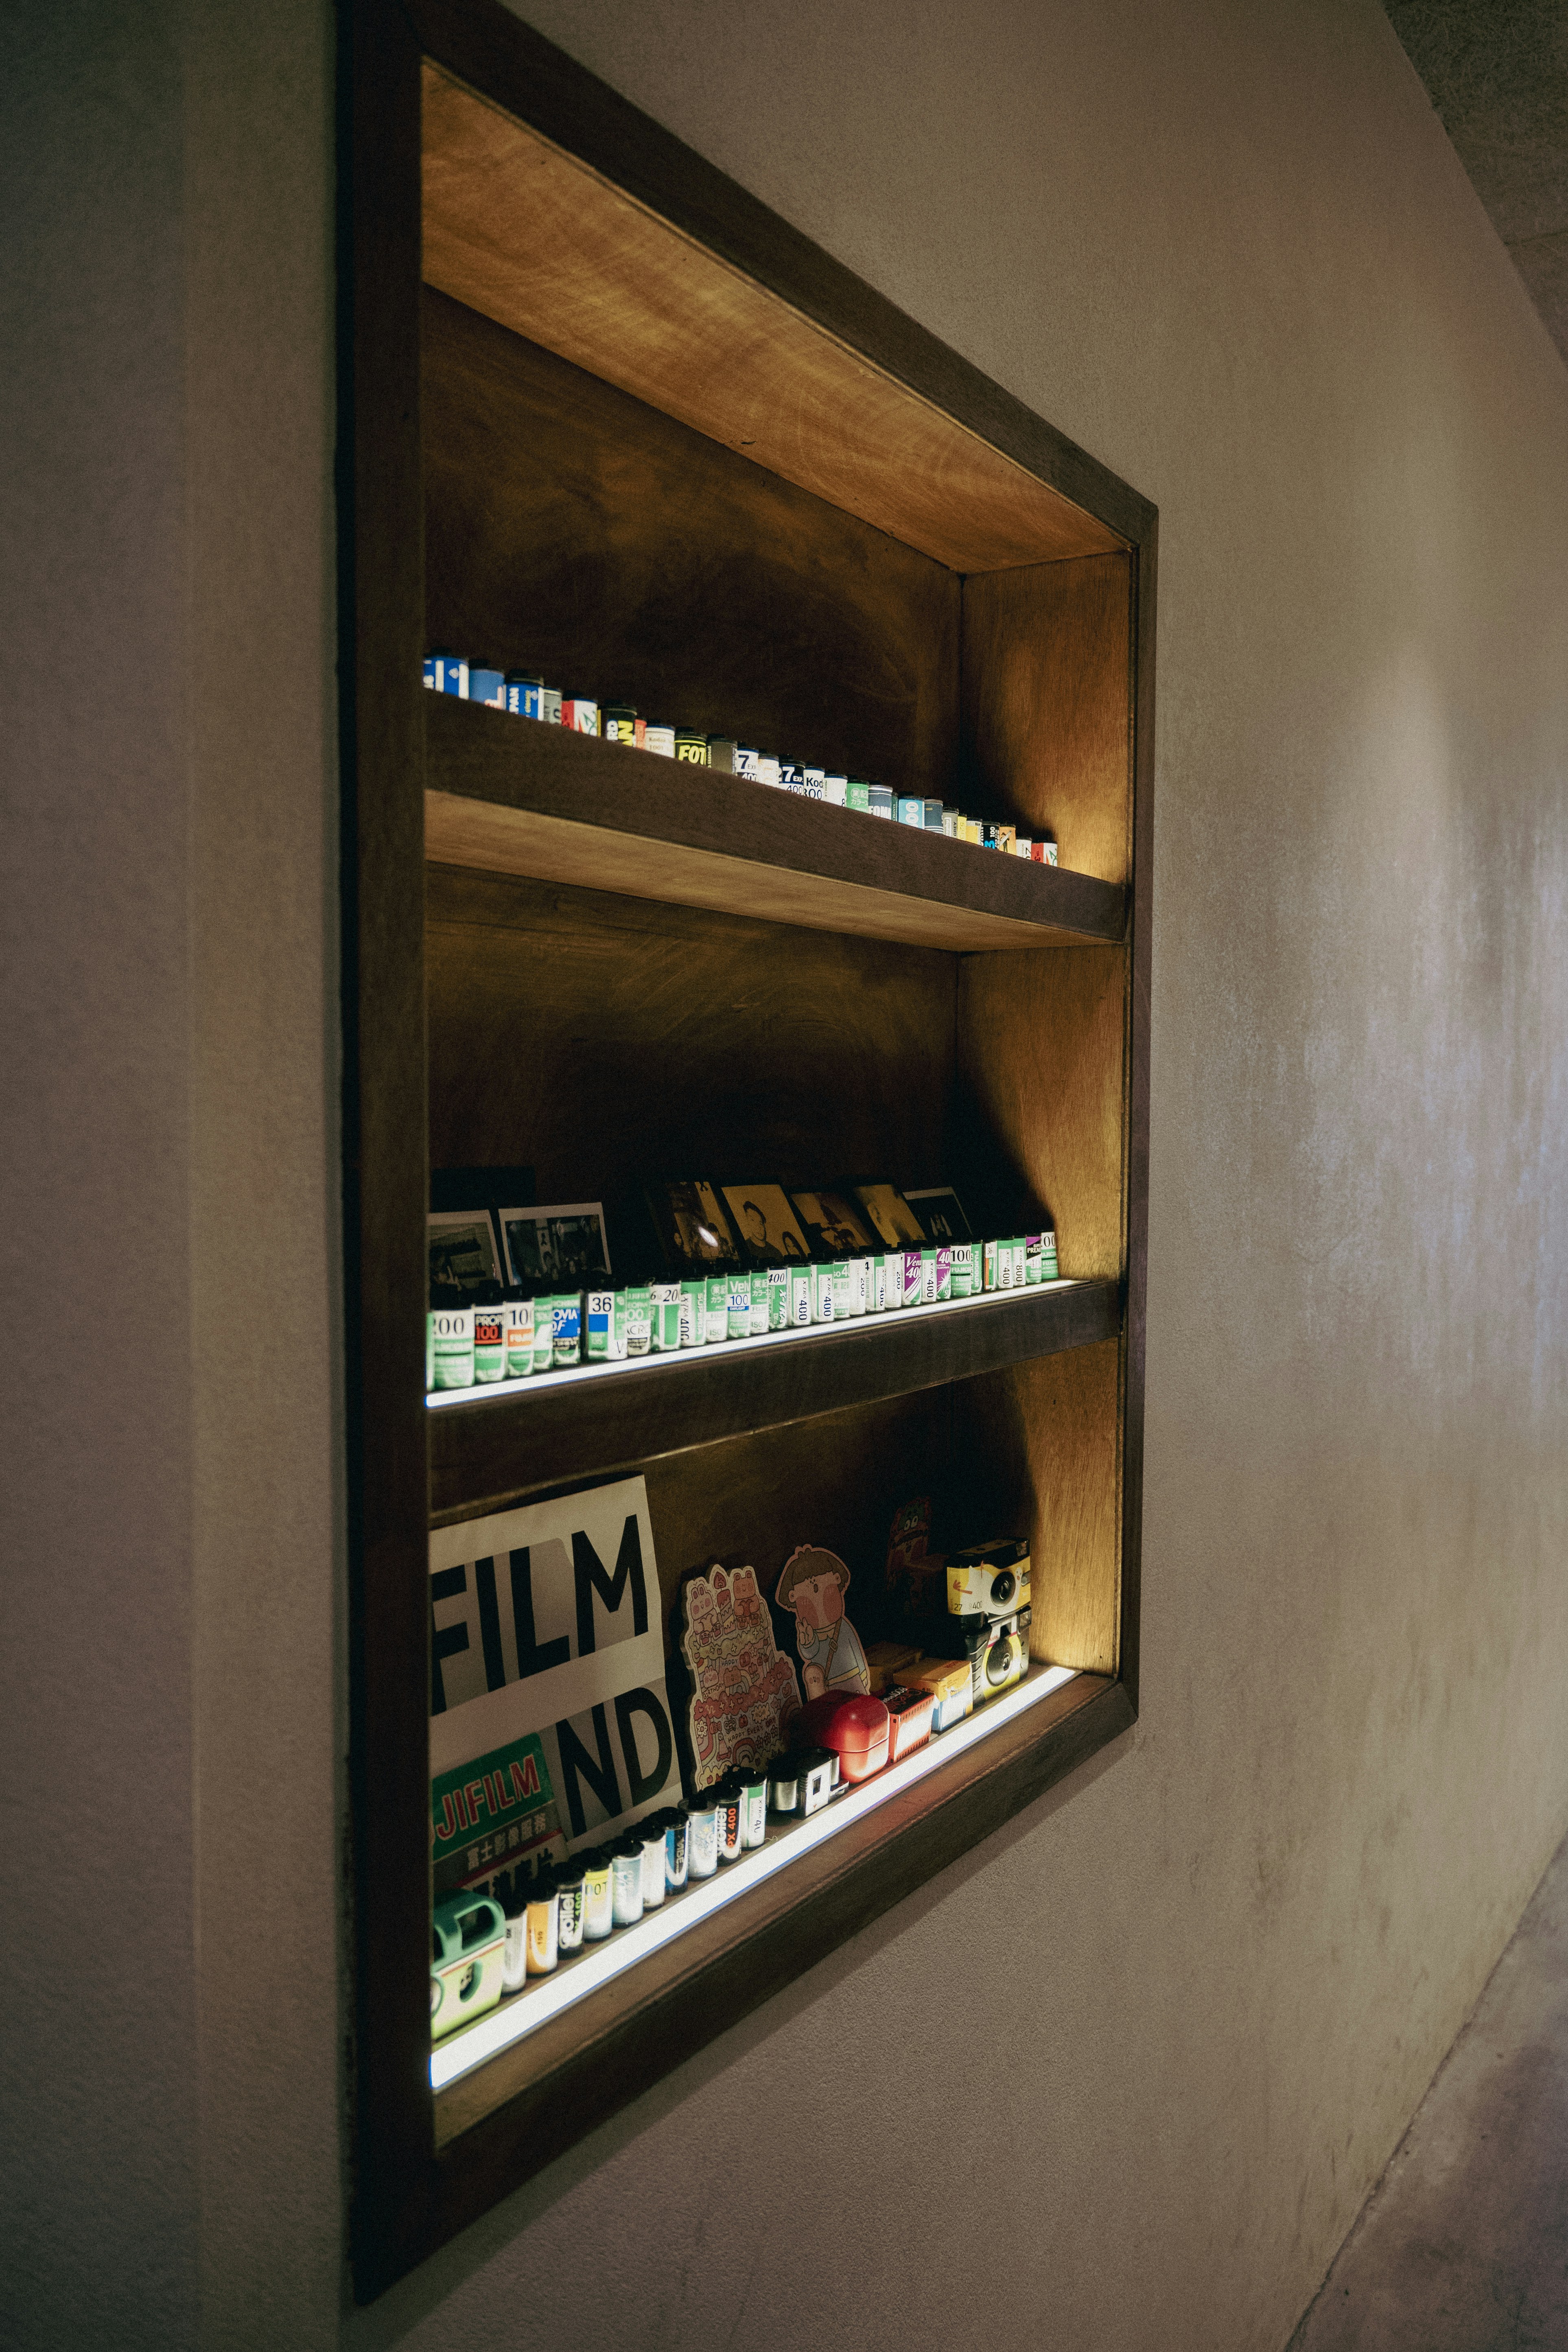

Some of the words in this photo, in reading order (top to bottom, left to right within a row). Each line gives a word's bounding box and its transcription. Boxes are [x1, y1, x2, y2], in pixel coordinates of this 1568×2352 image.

[738, 754, 749, 769] 7
[951, 1249, 971, 1262] 100
[768, 1273, 785, 1283] 400
[592, 1297, 612, 1312] 36
[730, 1294, 748, 1306] 100
[823, 1296, 831, 1317] 400
[798, 1300, 807, 1321] 400
[475, 1326, 499, 1340] 100
[954, 1603, 962, 1611] 27
[972, 1600, 982, 1610] 400
[430, 1513, 649, 1717] FILM
[721, 1658, 738, 1667] HAPPY
[703, 1683, 725, 1699] BIRTHDAY
[728, 1731, 745, 1743] HAPPY
[747, 1724, 763, 1735] EVERY
[727, 1807, 736, 1830] 400
